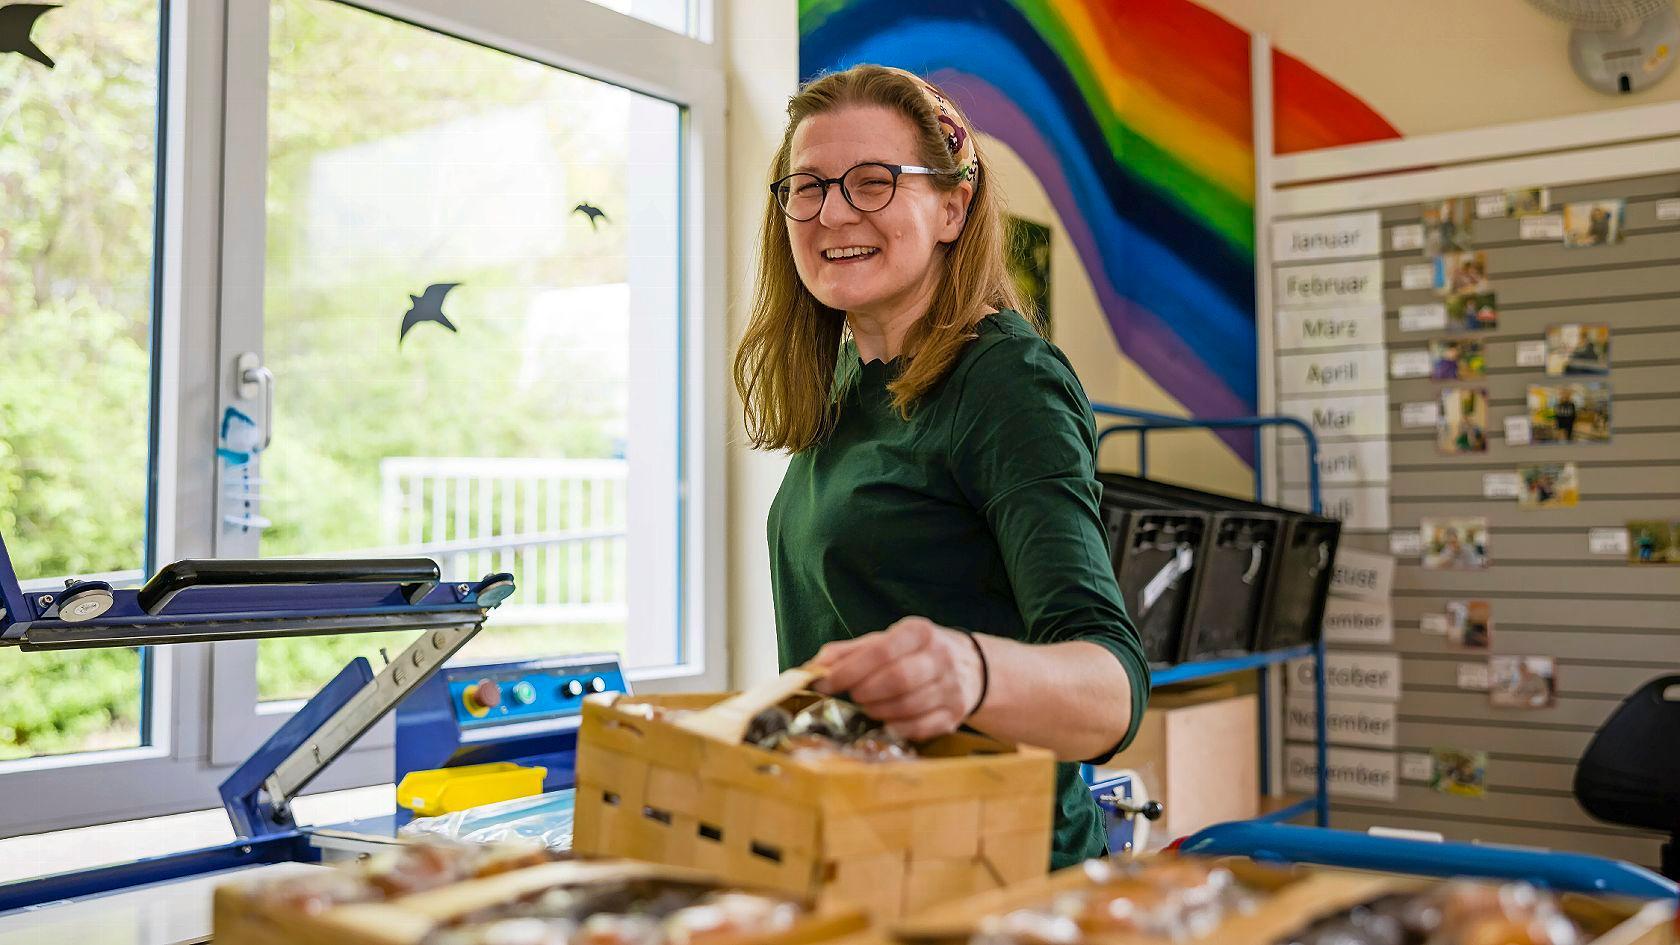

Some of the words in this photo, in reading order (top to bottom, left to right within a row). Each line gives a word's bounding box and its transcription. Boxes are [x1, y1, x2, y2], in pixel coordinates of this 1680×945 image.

[1290, 230, 1361, 251] Januar
[1286, 275, 1368, 297] Februar
[1303, 318, 1359, 338] März
[1306, 362, 1358, 384] April
[1319, 453, 1357, 475] uni
[1325, 612, 1383, 630] ember
[1297, 663, 1390, 688] Otober
[1289, 708, 1390, 734] Noember
[1289, 757, 1390, 787] Deember
